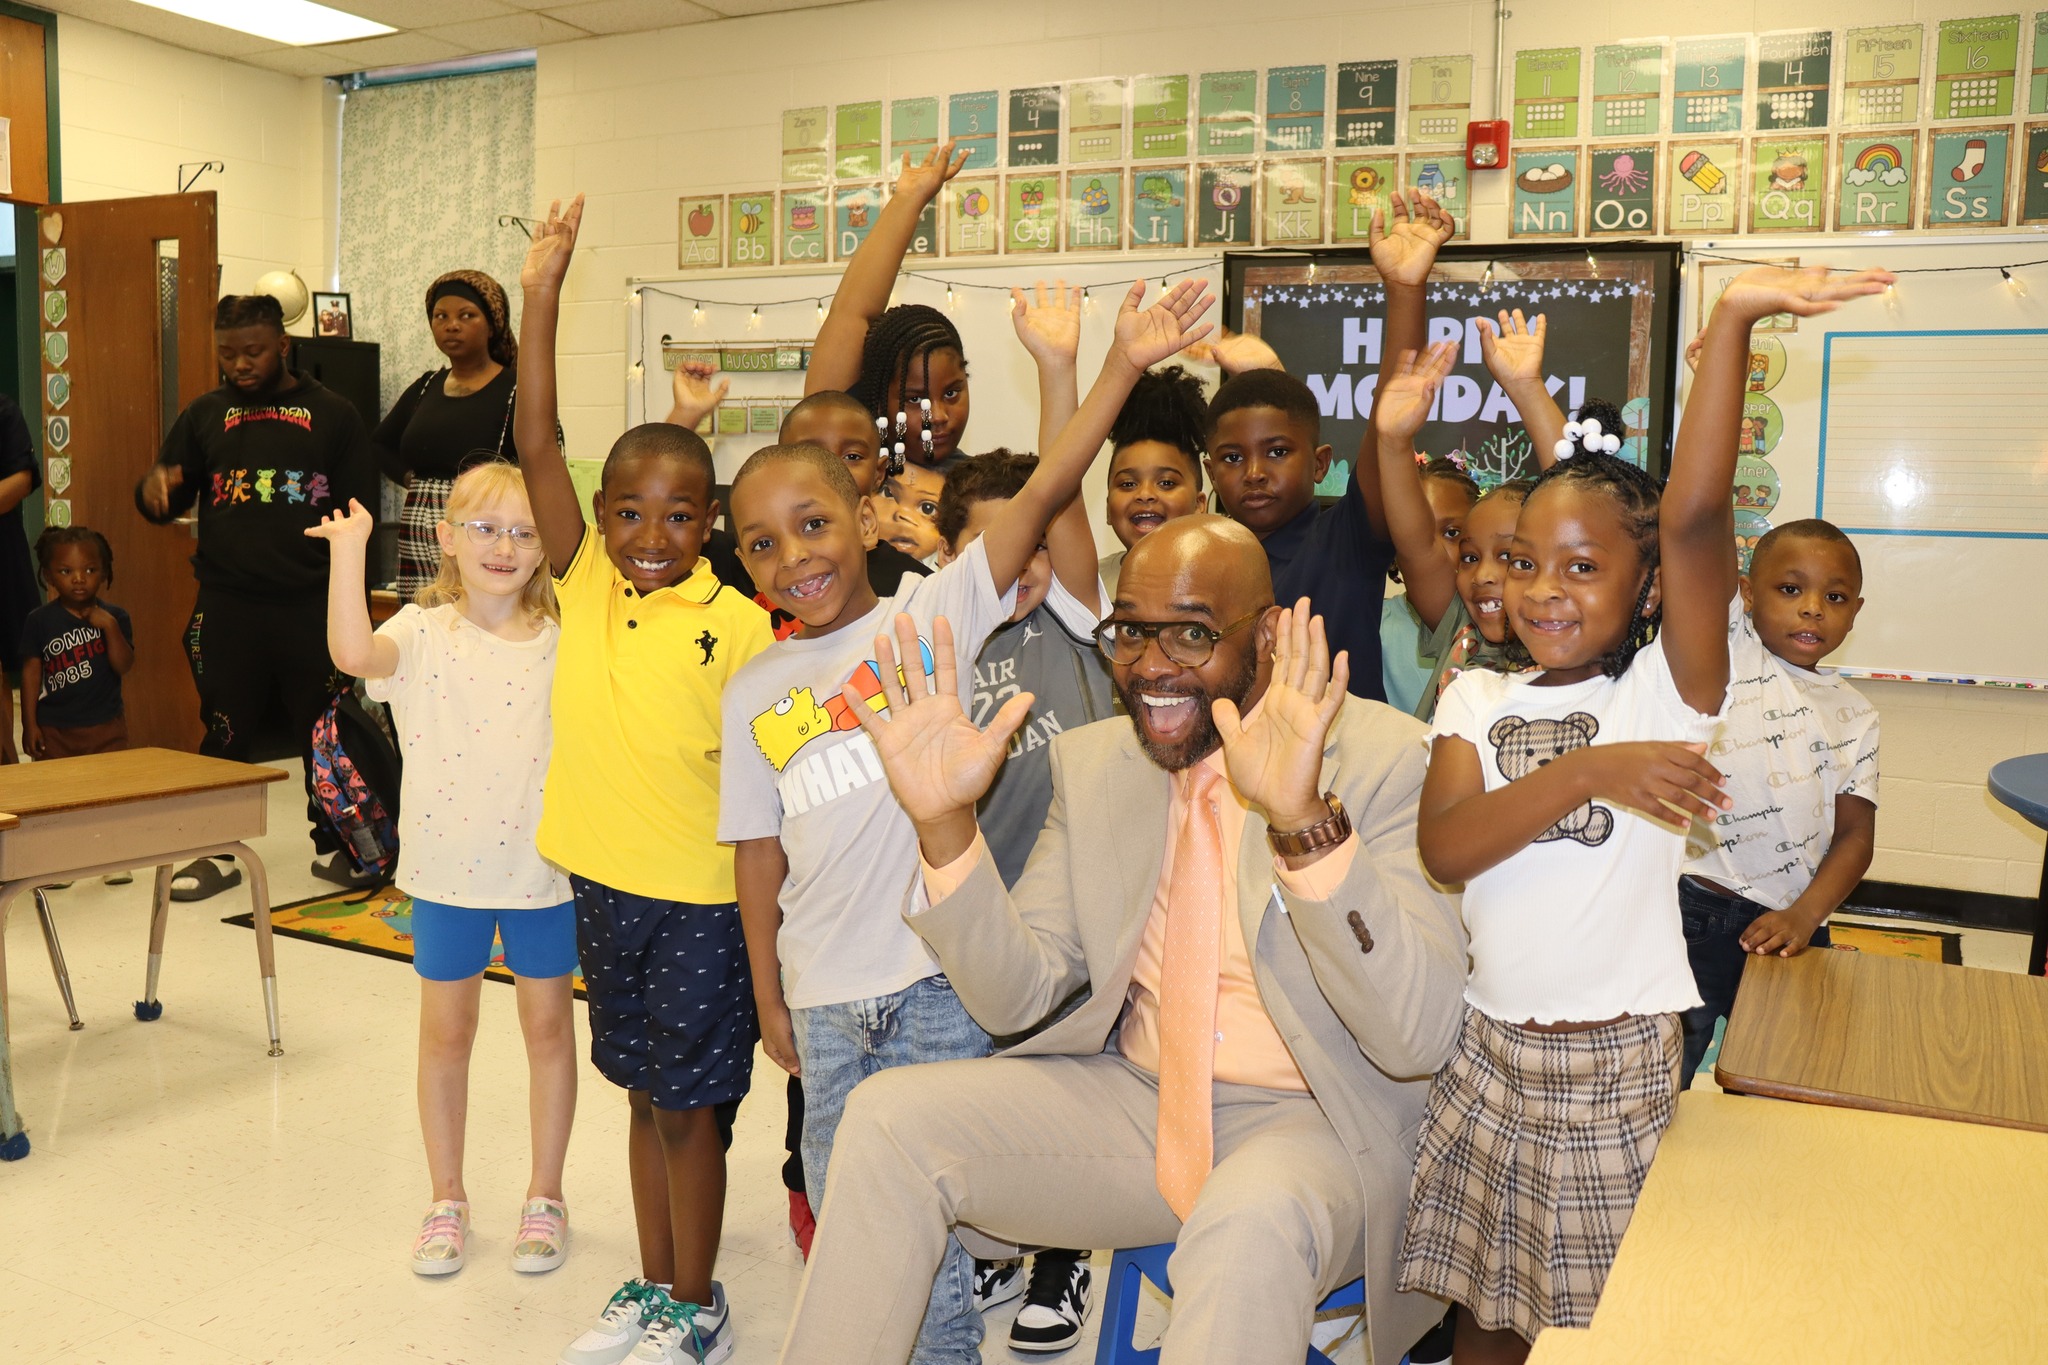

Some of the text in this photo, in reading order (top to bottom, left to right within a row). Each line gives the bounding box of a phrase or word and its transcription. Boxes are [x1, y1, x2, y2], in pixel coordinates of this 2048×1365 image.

[1856, 37, 1912, 53] Fifteen
[1948, 28, 2009, 44] Sixteen
[1761, 45, 1830, 60] Fourteen
[1965, 45, 1989, 70] 16
[1430, 65, 1452, 78] Ten
[1527, 58, 1568, 72] Eleven
[1700, 64, 1720, 88] 13
[1784, 61, 1804, 84] 14
[1873, 53, 1895, 79] 15
[1281, 77, 1310, 90] Eight
[1355, 72, 1380, 83] Nine
[1543, 74, 1552, 97] 11
[1618, 69, 1638, 93] 12
[1022, 97, 1048, 108] Four
[1223, 95, 1234, 112] 7
[1290, 91, 1302, 111] 8
[1359, 85, 1373, 106] 9
[1432, 79, 1452, 104] 10
[960, 101, 987, 113] Three
[1027, 109, 1040, 129] 4
[1089, 104, 1102, 124] 5
[1154, 103, 1167, 119] 6
[794, 117, 816, 128] Zero
[909, 119, 919, 138] 2
[968, 114, 978, 132] 3
[1594, 199, 1648, 230] Oo
[1682, 193, 1722, 230] Pp
[1761, 190, 1814, 227] Qq
[1856, 191, 1897, 224] Rr
[1944, 187, 1988, 219] Ss
[1214, 209, 1235, 243] Jj
[1277, 210, 1310, 239] Kk
[1521, 201, 1567, 231] Nn
[961, 222, 986, 248] Ff
[1013, 218, 1051, 249] Gg
[1075, 217, 1112, 244] Hh
[1148, 215, 1168, 243] Ii
[686, 240, 717, 264] Aa
[737, 237, 765, 261] Bb
[787, 234, 820, 259] Cc
[842, 231, 859, 256] D
[726, 353, 775, 369] AUGUST
[279, 406, 312, 432] DEAD
[1735, 465, 1770, 478] rtner
[43, 626, 101, 662] TOMM
[190, 612, 204, 661] FUTURE
[48, 659, 93, 692] 1985
[974, 657, 1016, 689] AIR
[778, 731, 885, 819] WHAT
